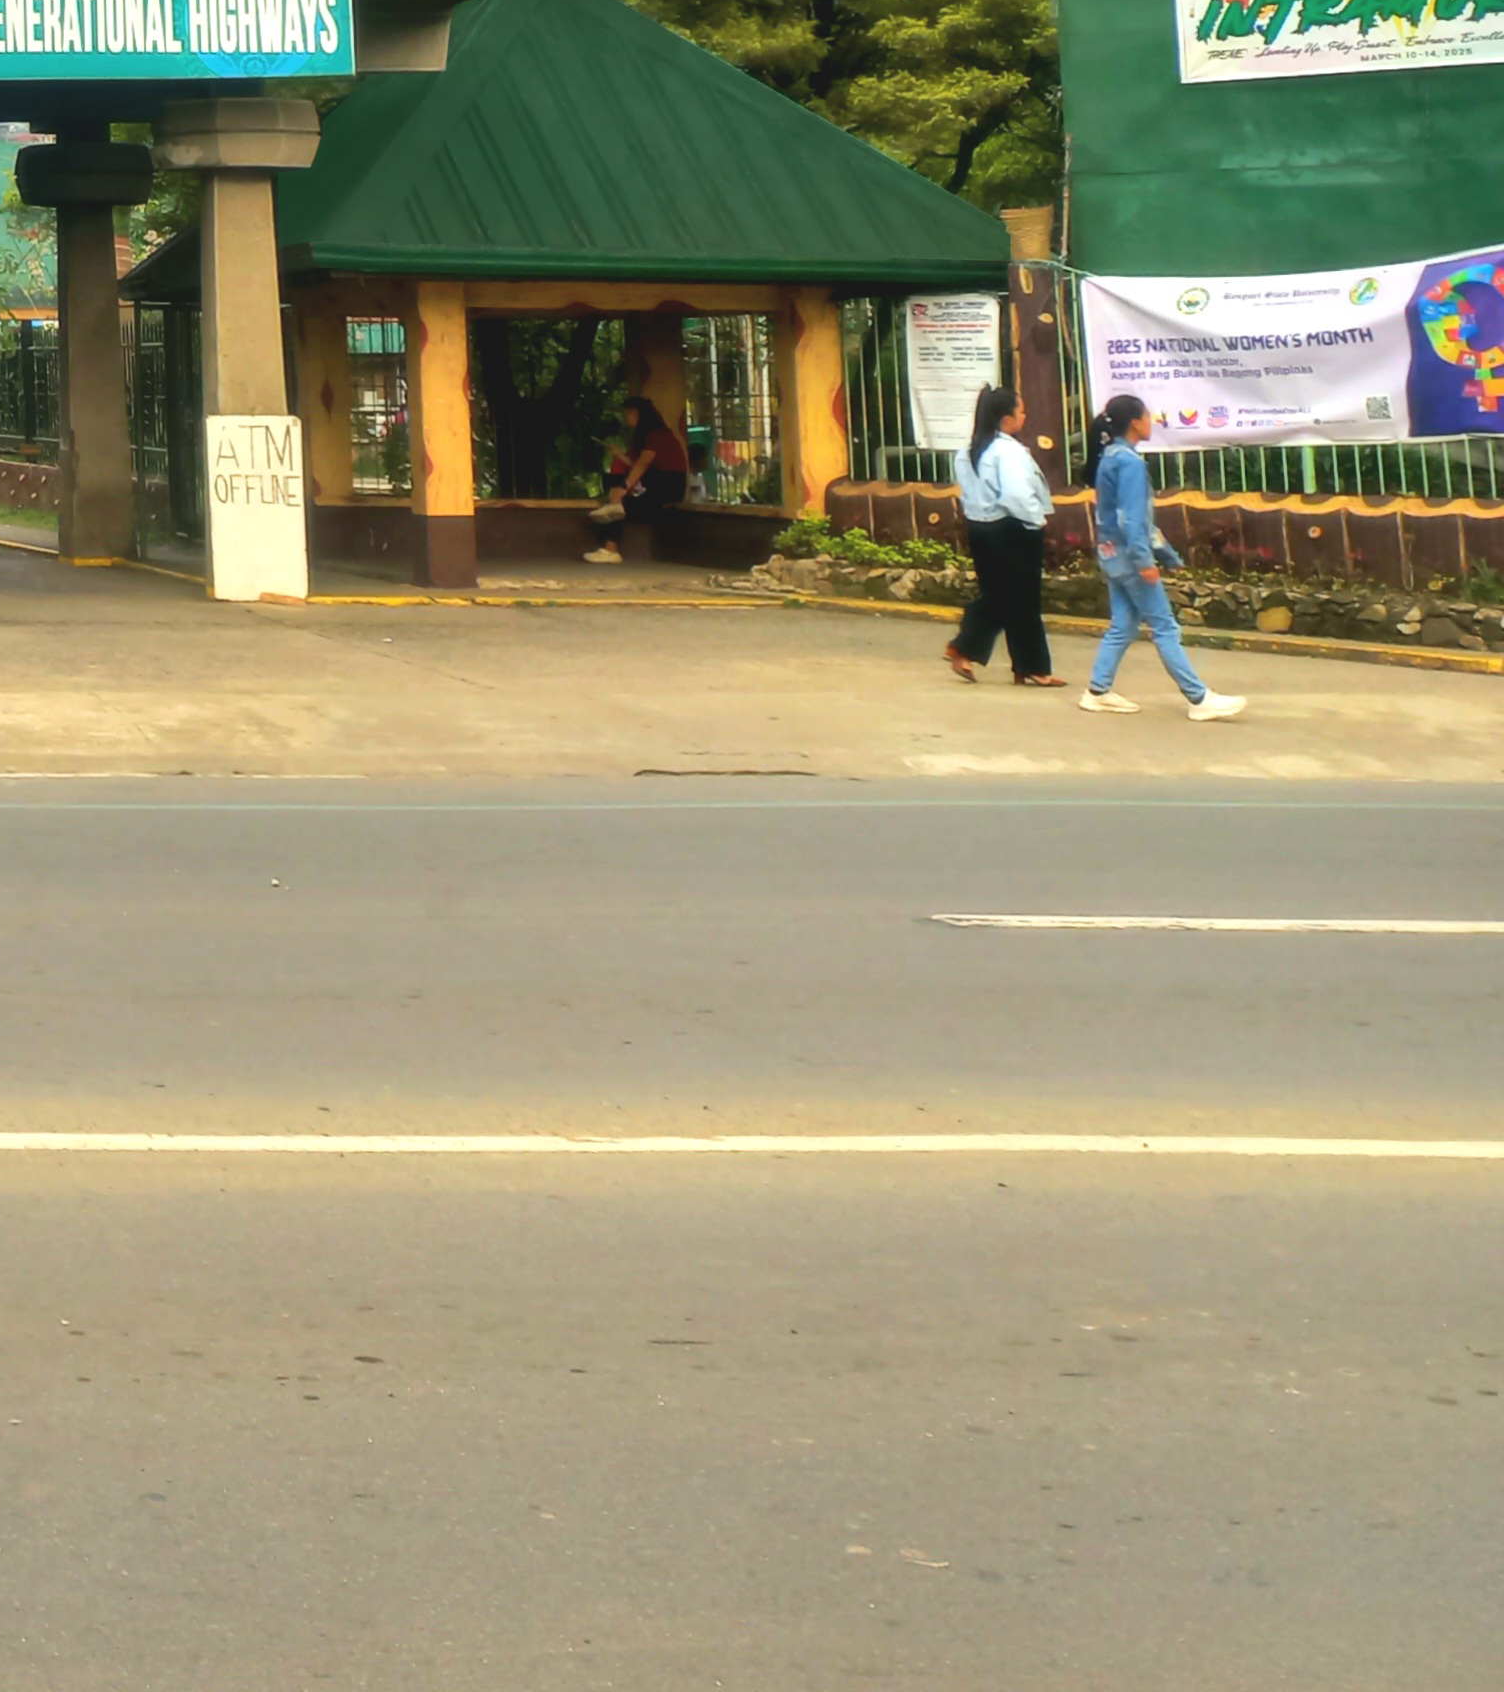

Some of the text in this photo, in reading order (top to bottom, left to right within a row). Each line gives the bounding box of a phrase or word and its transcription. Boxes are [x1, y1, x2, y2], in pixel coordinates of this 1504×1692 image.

[1360, 52, 1402, 62] MARCH
[1444, 48, 1473, 57] 2025
[1145, 338, 1221, 354] NATIONAL
[1222, 333, 1302, 351] WOMEN'S
[1306, 327, 1373, 347] MONTH
[216, 424, 294, 471] ATM
[214, 473, 301, 507] OFFLINE
